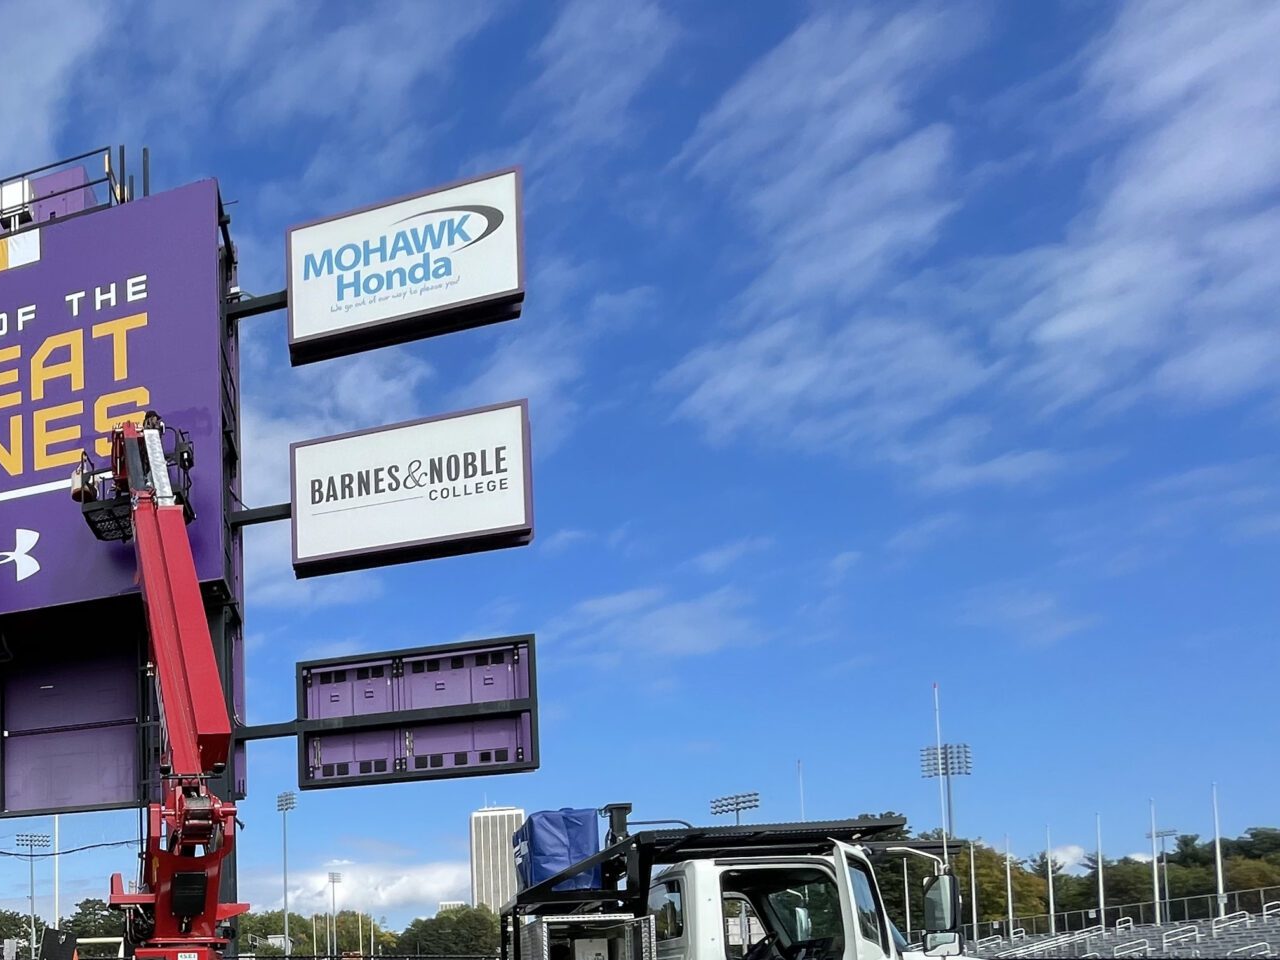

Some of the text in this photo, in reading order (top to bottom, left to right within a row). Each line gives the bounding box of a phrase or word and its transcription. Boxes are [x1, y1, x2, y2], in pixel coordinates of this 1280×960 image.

[303, 214, 471, 281] MOHAWK
[65, 274, 148, 317] THE
[336, 252, 452, 302] Honda
[429, 478, 509, 501] COLLEGE
